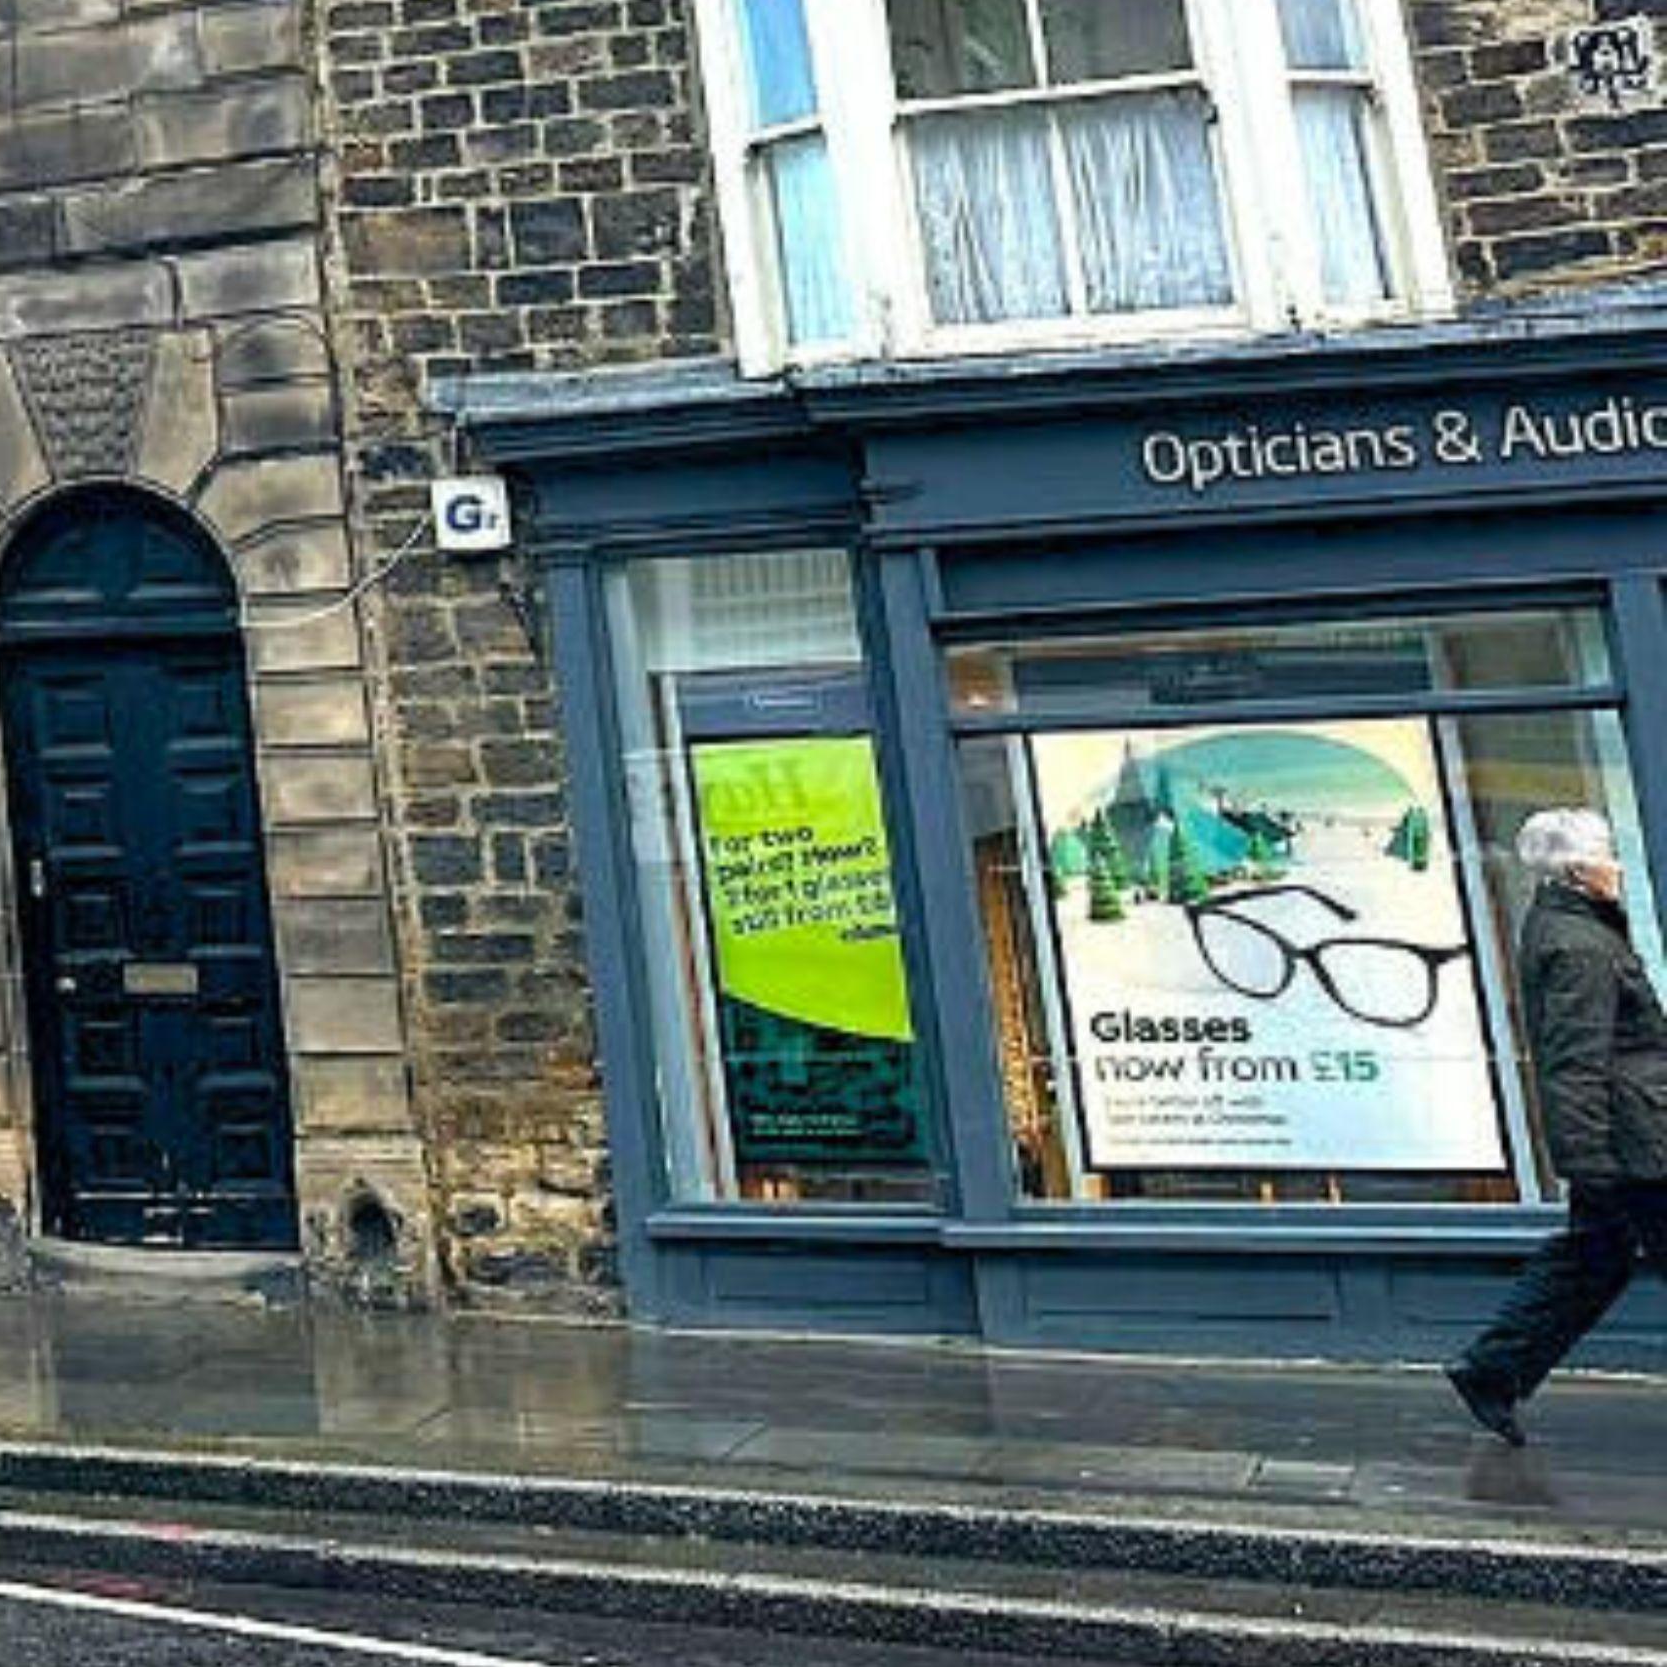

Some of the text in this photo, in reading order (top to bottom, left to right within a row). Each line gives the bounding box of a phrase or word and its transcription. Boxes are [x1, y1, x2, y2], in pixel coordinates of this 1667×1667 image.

[1142, 423, 1418, 492] Opticians
[1432, 409, 1483, 464] &
[760, 825, 814, 847] two
[1089, 1006, 1254, 1045] Glasses
[1094, 1045, 1381, 1083] now from £15
